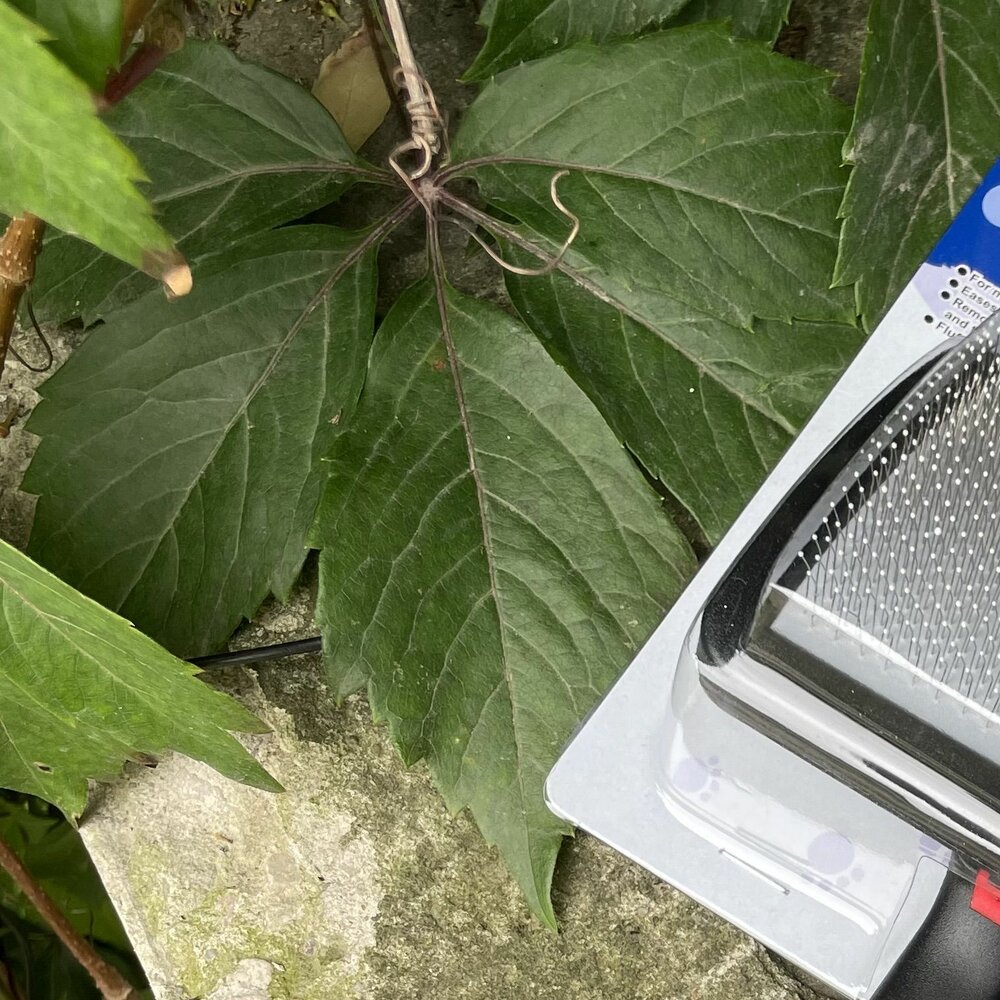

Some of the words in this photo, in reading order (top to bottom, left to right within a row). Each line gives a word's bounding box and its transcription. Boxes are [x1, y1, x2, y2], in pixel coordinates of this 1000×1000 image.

[961, 285, 998, 312] Eases
[944, 311, 970, 329] and
[936, 321, 962, 338] Flu
